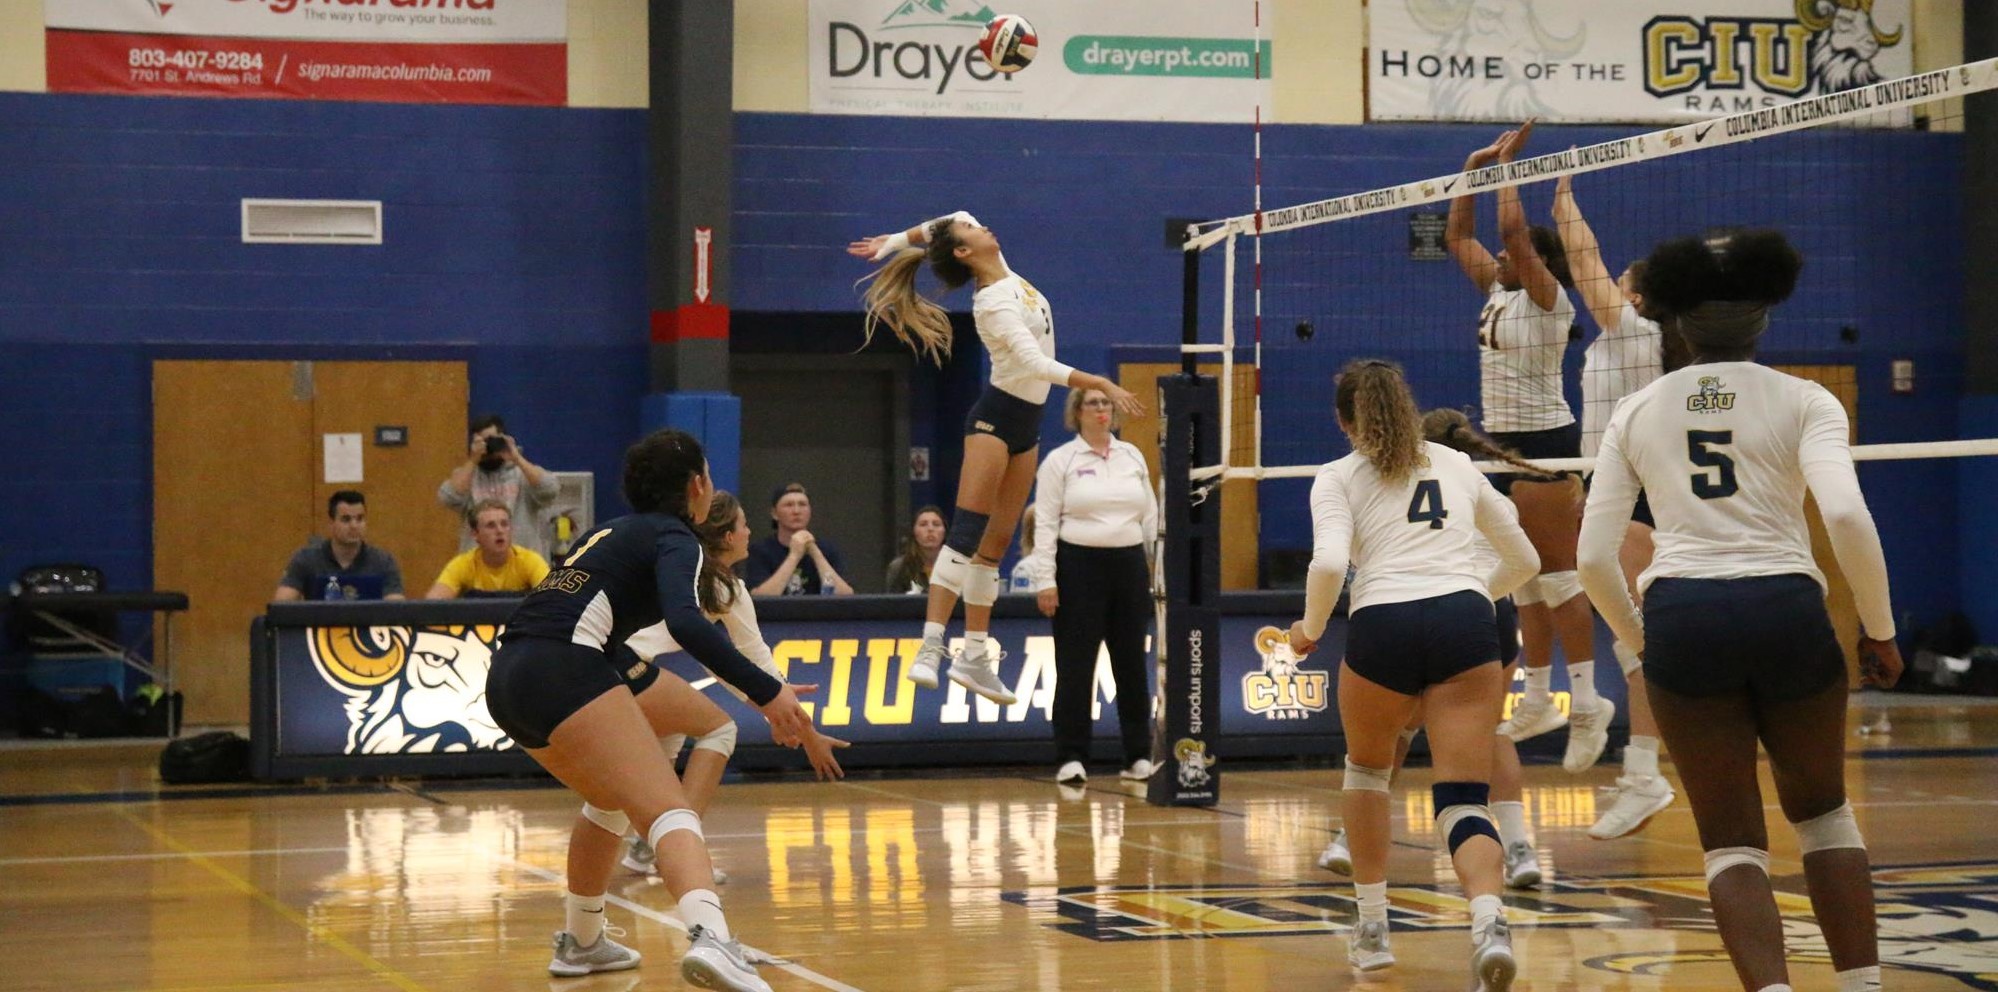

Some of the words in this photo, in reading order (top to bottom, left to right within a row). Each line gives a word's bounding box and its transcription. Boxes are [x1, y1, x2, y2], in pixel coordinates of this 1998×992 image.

[304, 8, 327, 20] The
[330, 12, 354, 23] way
[358, 11, 372, 22] to
[374, 12, 405, 25] grow
[409, 14, 436, 26] your
[439, 13, 497, 26] business.
[128, 48, 264, 70] 803-407-9284
[129, 68, 161, 82] 7701
[186, 70, 240, 85] Andrews
[297, 60, 492, 82] signaramacolumbia.com
[829, 21, 1014, 95] Draye
[1082, 41, 1250, 72] drayerpt.com
[1381, 50, 1504, 79] HOME
[1523, 62, 1560, 80] OF
[1572, 63, 1626, 81] THE
[1643, 15, 1813, 99] CIU
[1726, 109, 1780, 137] COLUMBIA
[1782, 88, 1872, 125] INTERNATIONAL
[1876, 70, 1951, 106] UNIVERSITY
[1466, 166, 1504, 189] COLUMBIA
[1508, 152, 1576, 181] INTERNATIONAL
[1579, 138, 1633, 168] UNIVERSITY
[1687, 392, 1736, 412] CIU
[1686, 429, 1739, 500] 5
[1407, 479, 1449, 530] 4
[1188, 629, 1204, 675] sports
[1188, 677, 1204, 734] imports
[1245, 672, 1328, 712] CIU
[1266, 708, 1310, 721] RAMS
